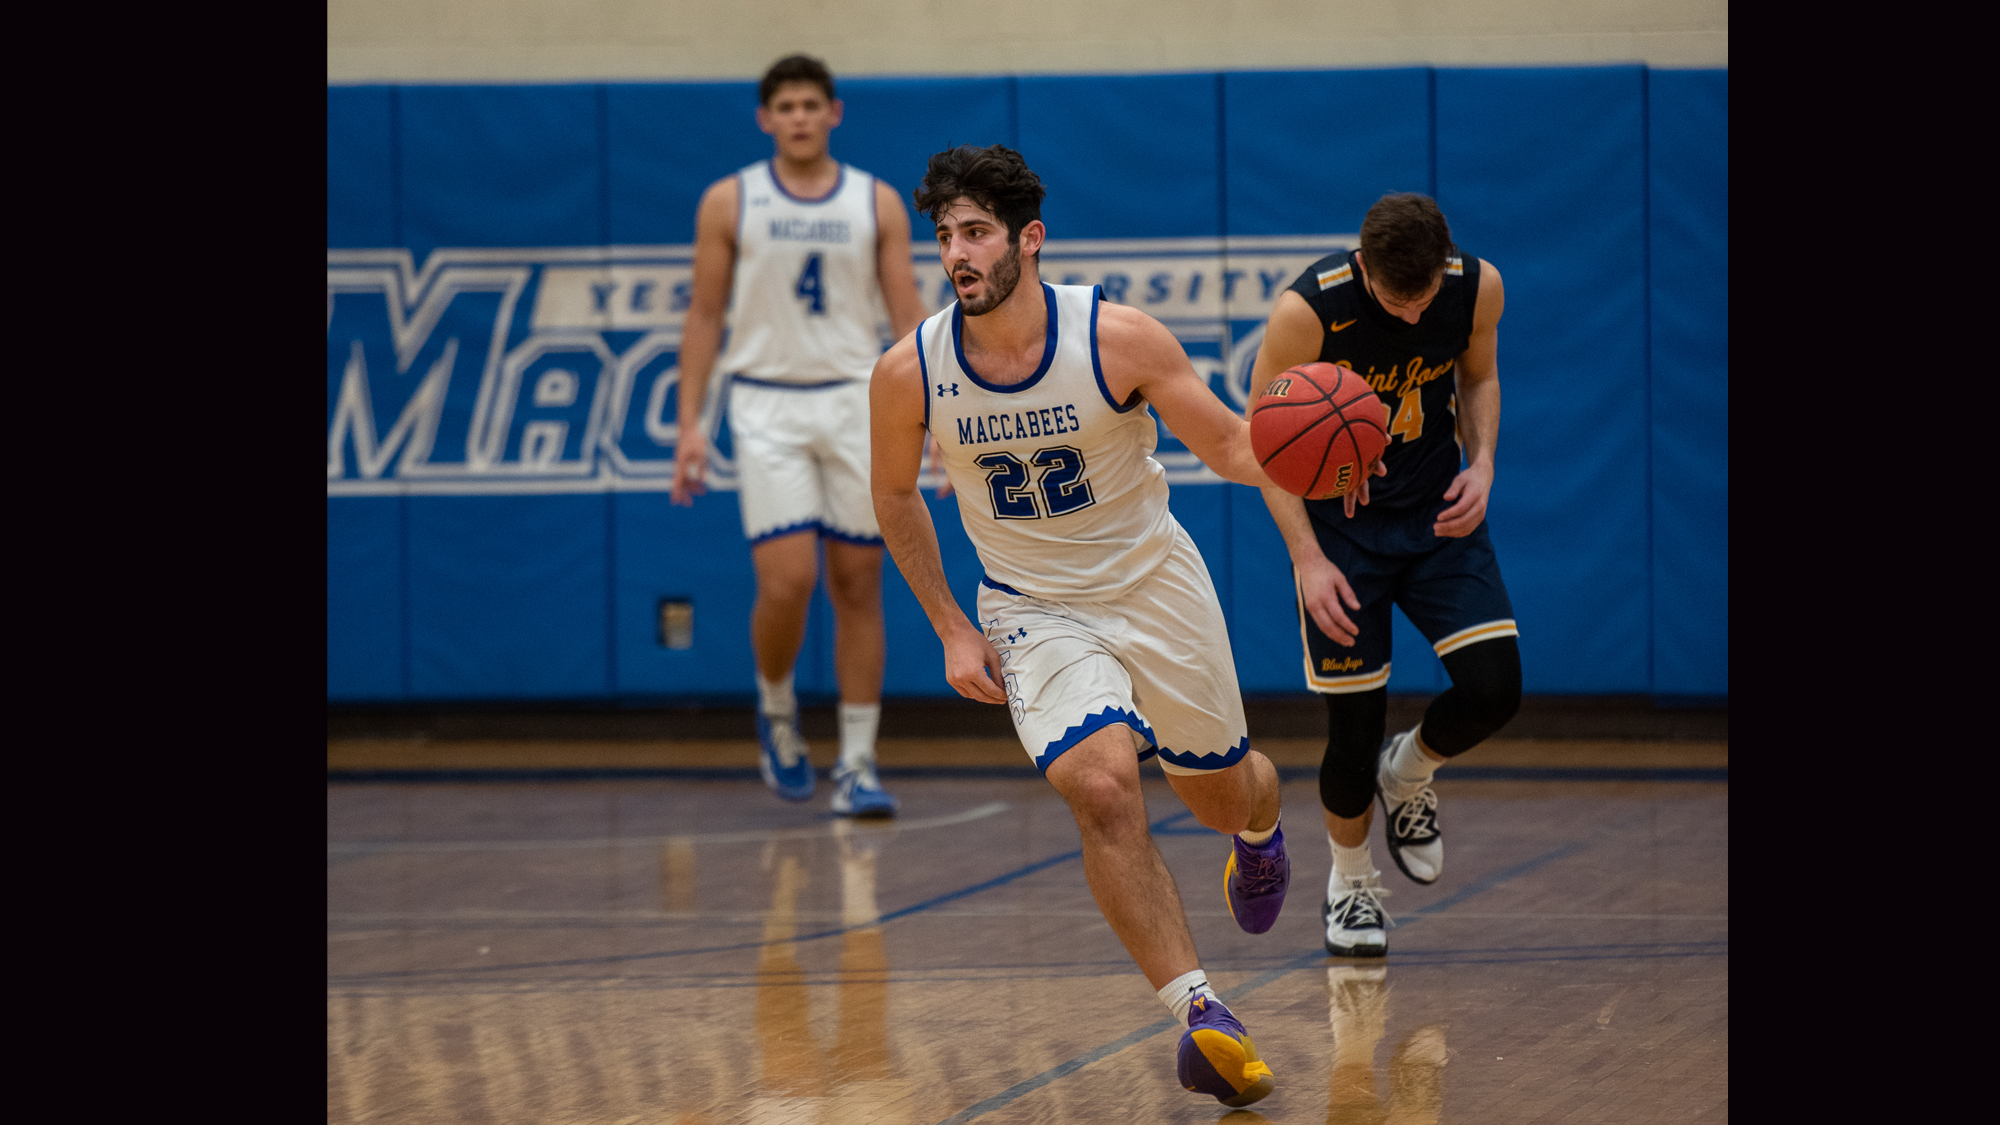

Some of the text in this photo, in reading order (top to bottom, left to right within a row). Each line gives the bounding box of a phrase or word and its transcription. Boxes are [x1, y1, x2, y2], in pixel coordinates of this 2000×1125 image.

[794, 251, 827, 316] 4
[957, 404, 1080, 445] MACCABEES
[1381, 387, 1425, 444] 4
[973, 445, 1097, 520] 22
